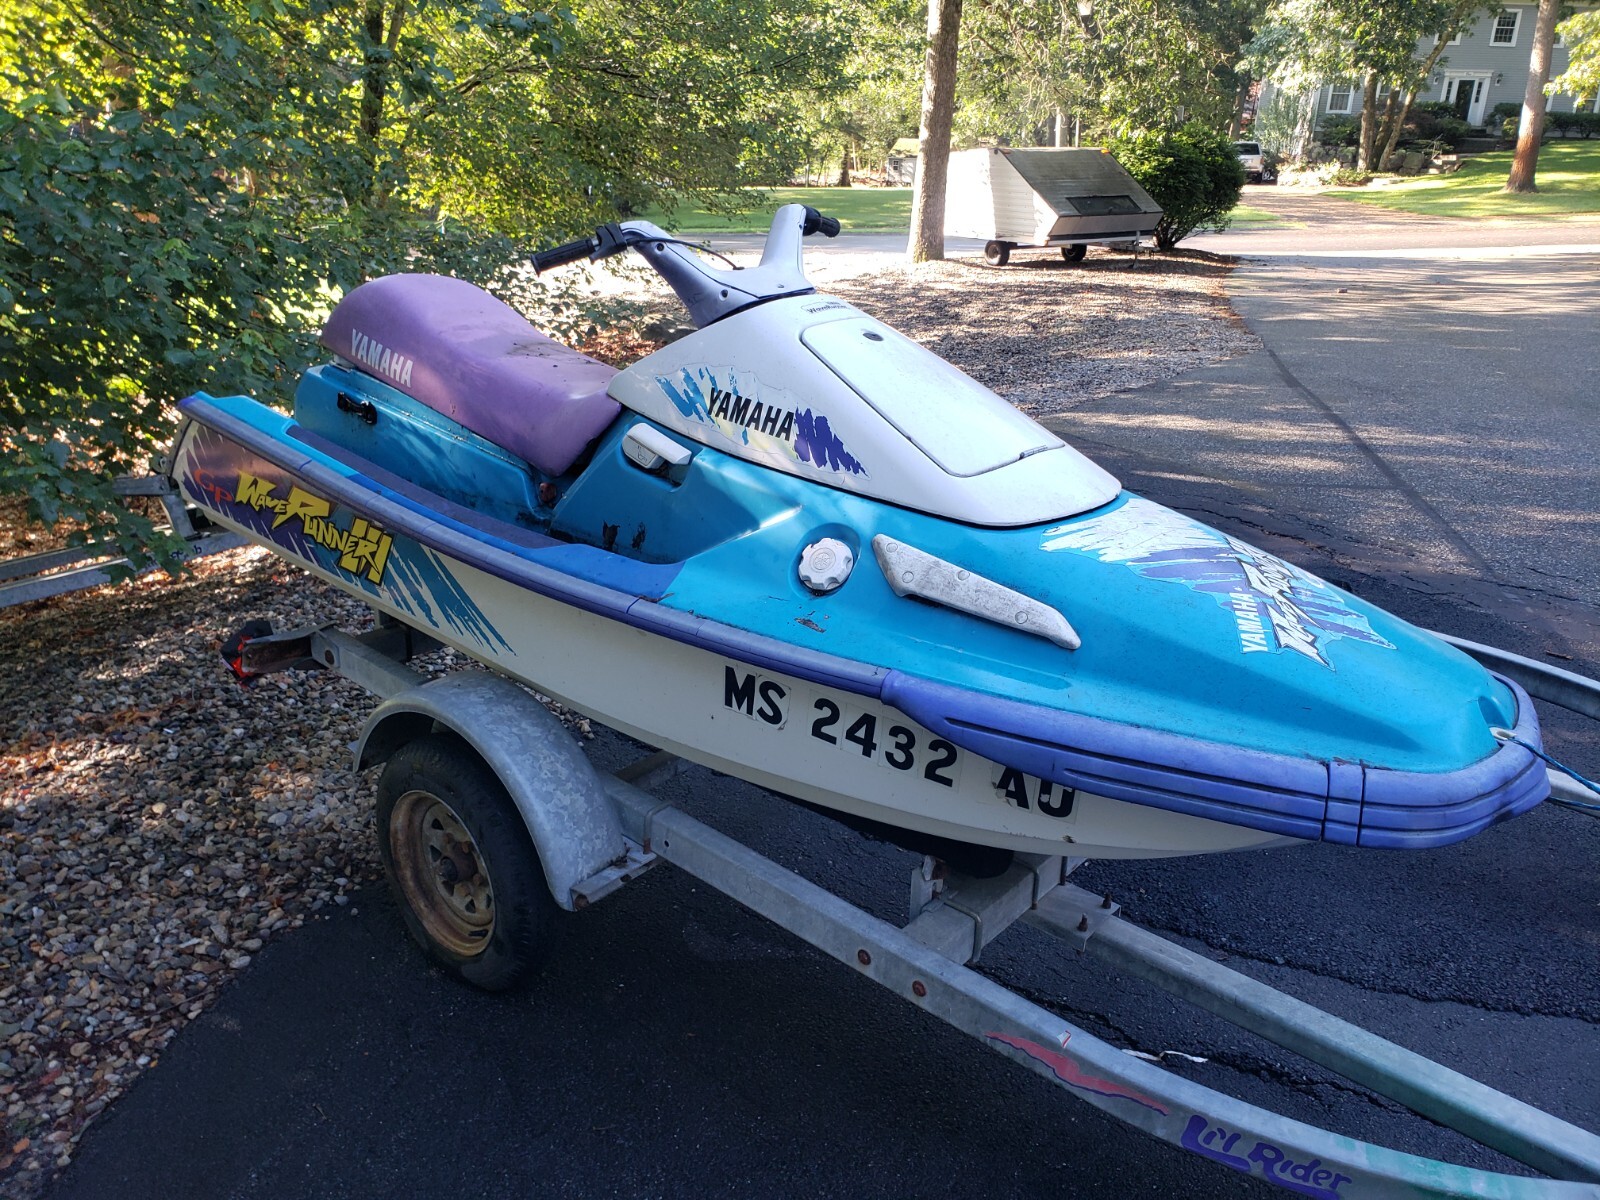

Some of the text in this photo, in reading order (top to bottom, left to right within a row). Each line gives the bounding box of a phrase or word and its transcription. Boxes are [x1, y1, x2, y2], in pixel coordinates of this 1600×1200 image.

[350, 328, 414, 389] YAMAHA
[707, 387, 795, 441] YAMAHA
[1229, 591, 1269, 652] YAMAHA
[724, 665, 1076, 818] MS 2432 AU
[1247, 1142, 1353, 1200] Rider
